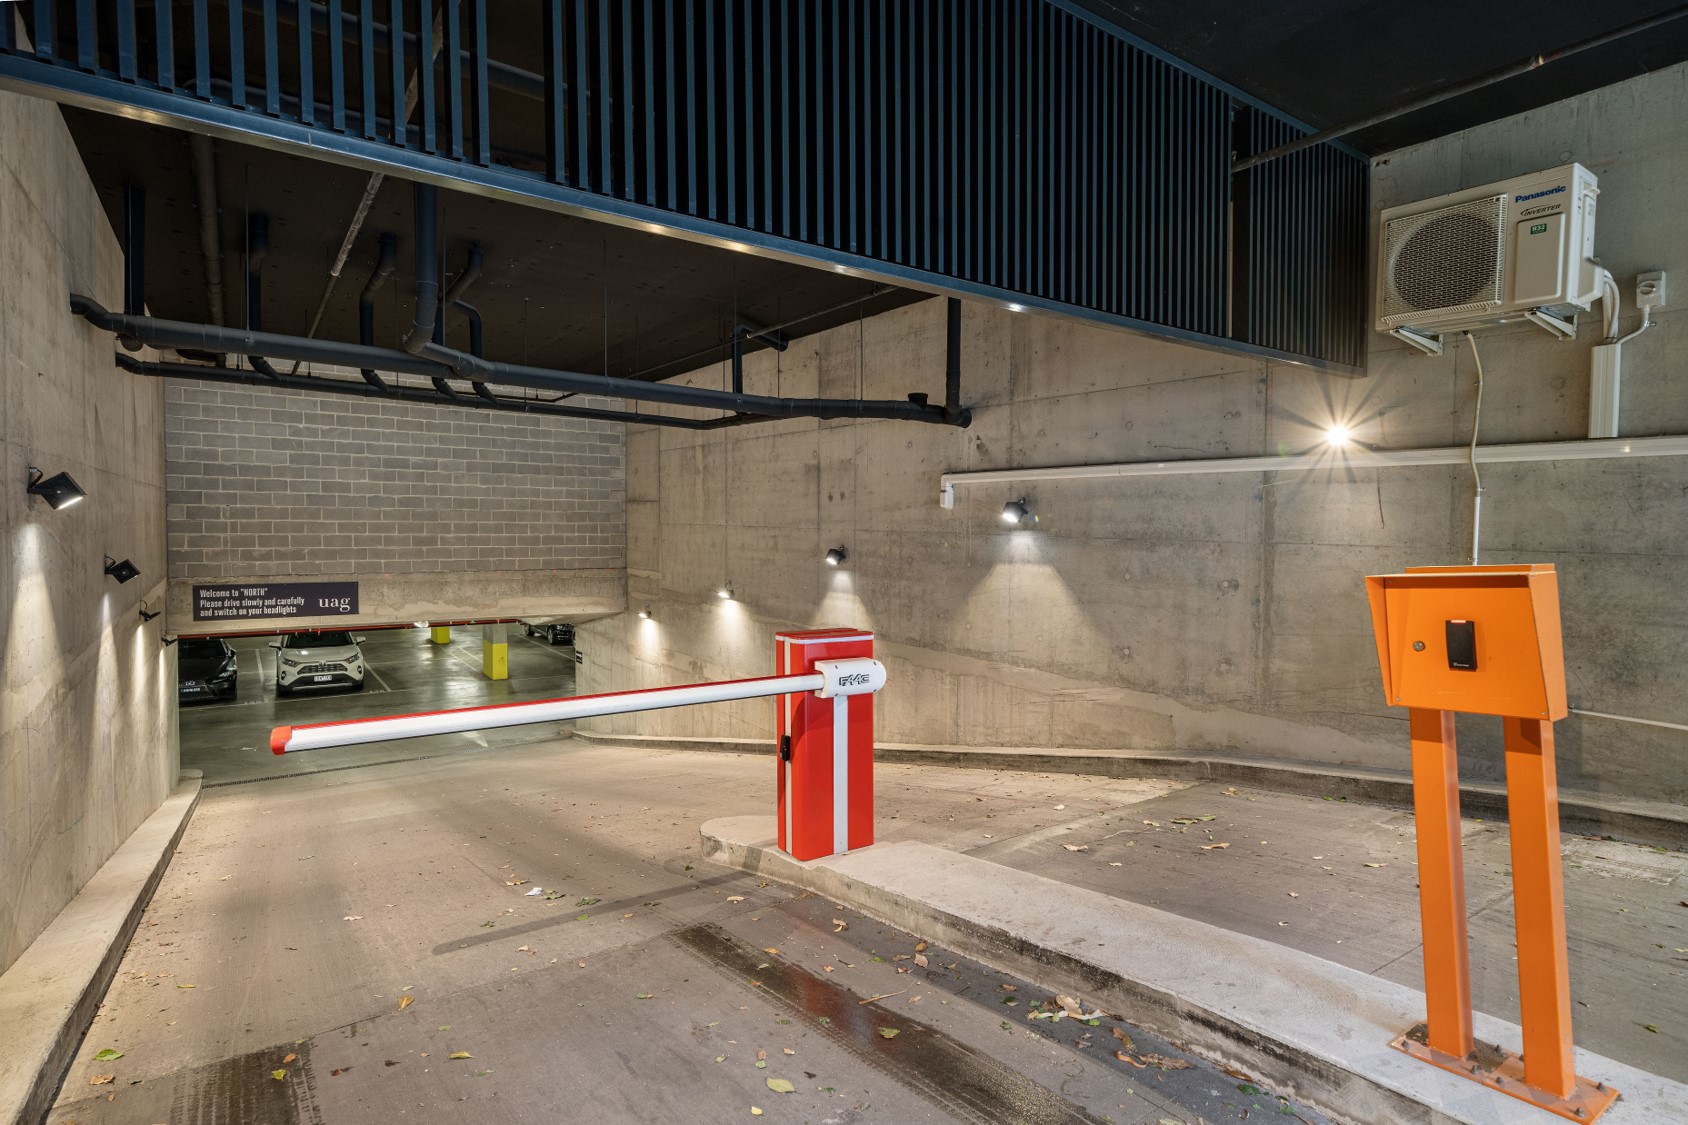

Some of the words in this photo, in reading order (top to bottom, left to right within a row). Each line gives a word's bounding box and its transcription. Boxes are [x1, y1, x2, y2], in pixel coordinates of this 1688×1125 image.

[1515, 186, 1566, 203] Panasonic
[1522, 204, 1561, 216] INVERTER
[200, 589, 230, 598] Welcome
[241, 588, 268, 596] "NORTH"
[200, 600, 222, 608] Please
[242, 598, 262, 607] slowly
[264, 598, 276, 606] and
[277, 596, 305, 606] carefully
[319, 598, 350, 612] uag
[200, 608, 212, 616] and
[248, 608, 262, 616] your
[264, 606, 296, 614] headlights
[839, 674, 870, 686] FAAC
